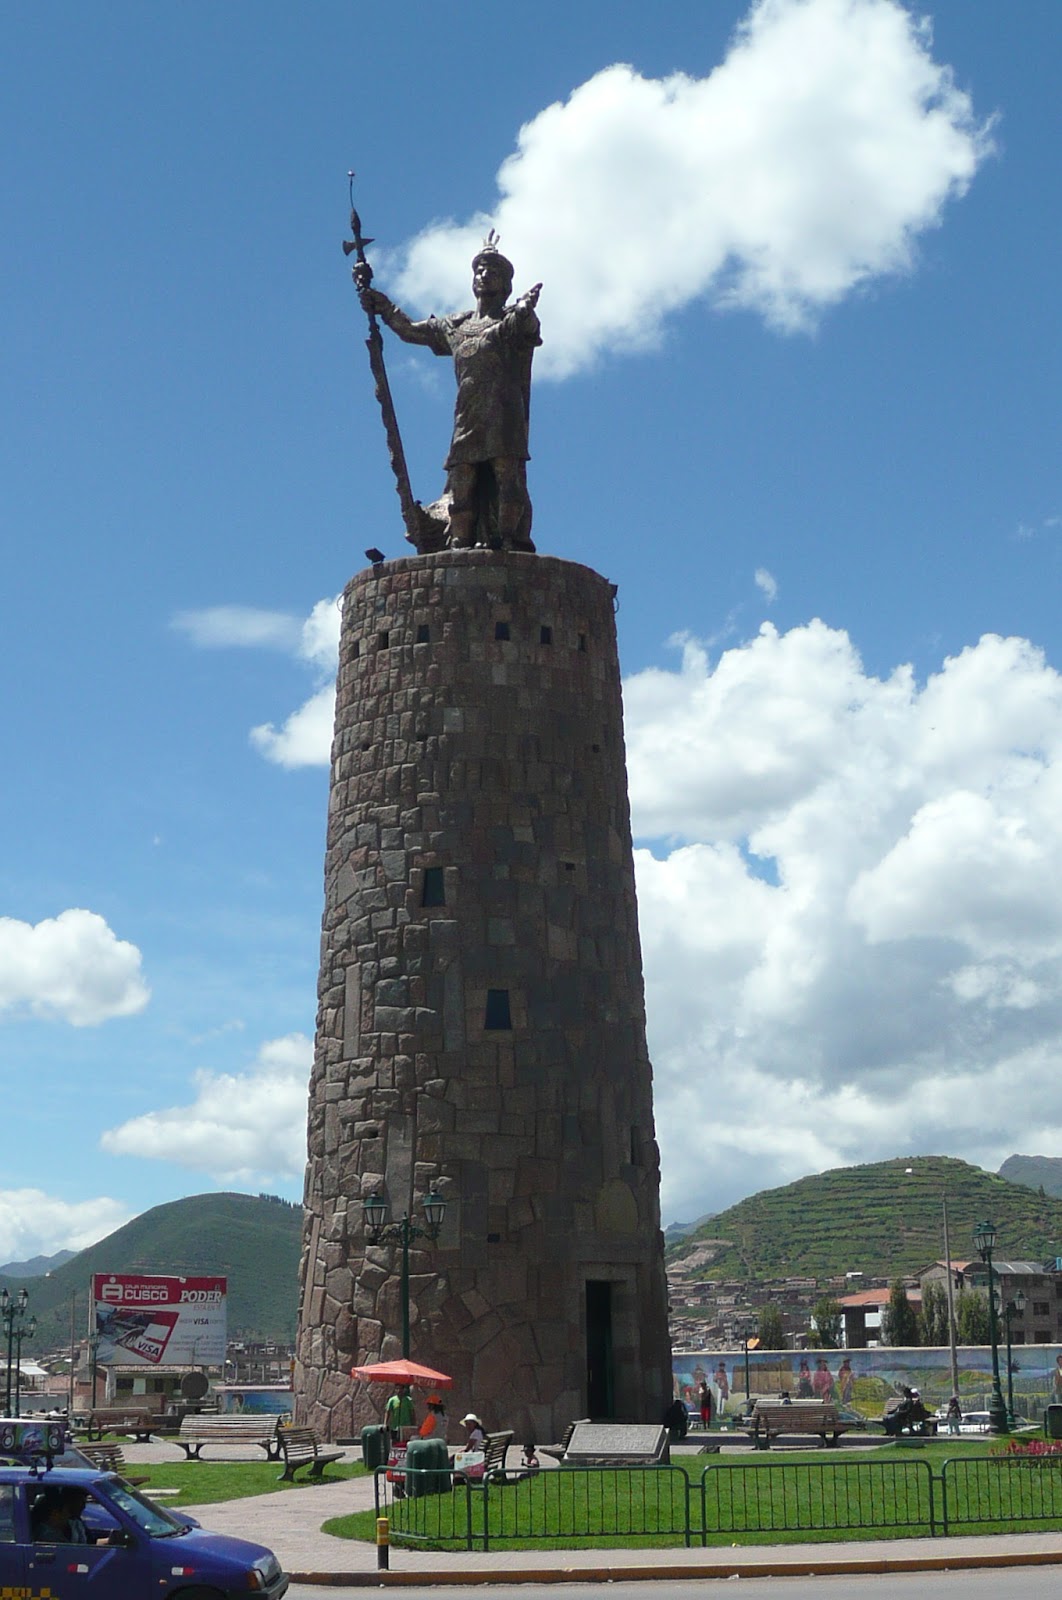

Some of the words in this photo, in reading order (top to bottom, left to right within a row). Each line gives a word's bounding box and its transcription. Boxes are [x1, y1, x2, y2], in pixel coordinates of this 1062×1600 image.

[124, 1290, 169, 1301] CUSCO
[179, 1290, 222, 1303] PODER
[136, 1341, 161, 1356] VISA
